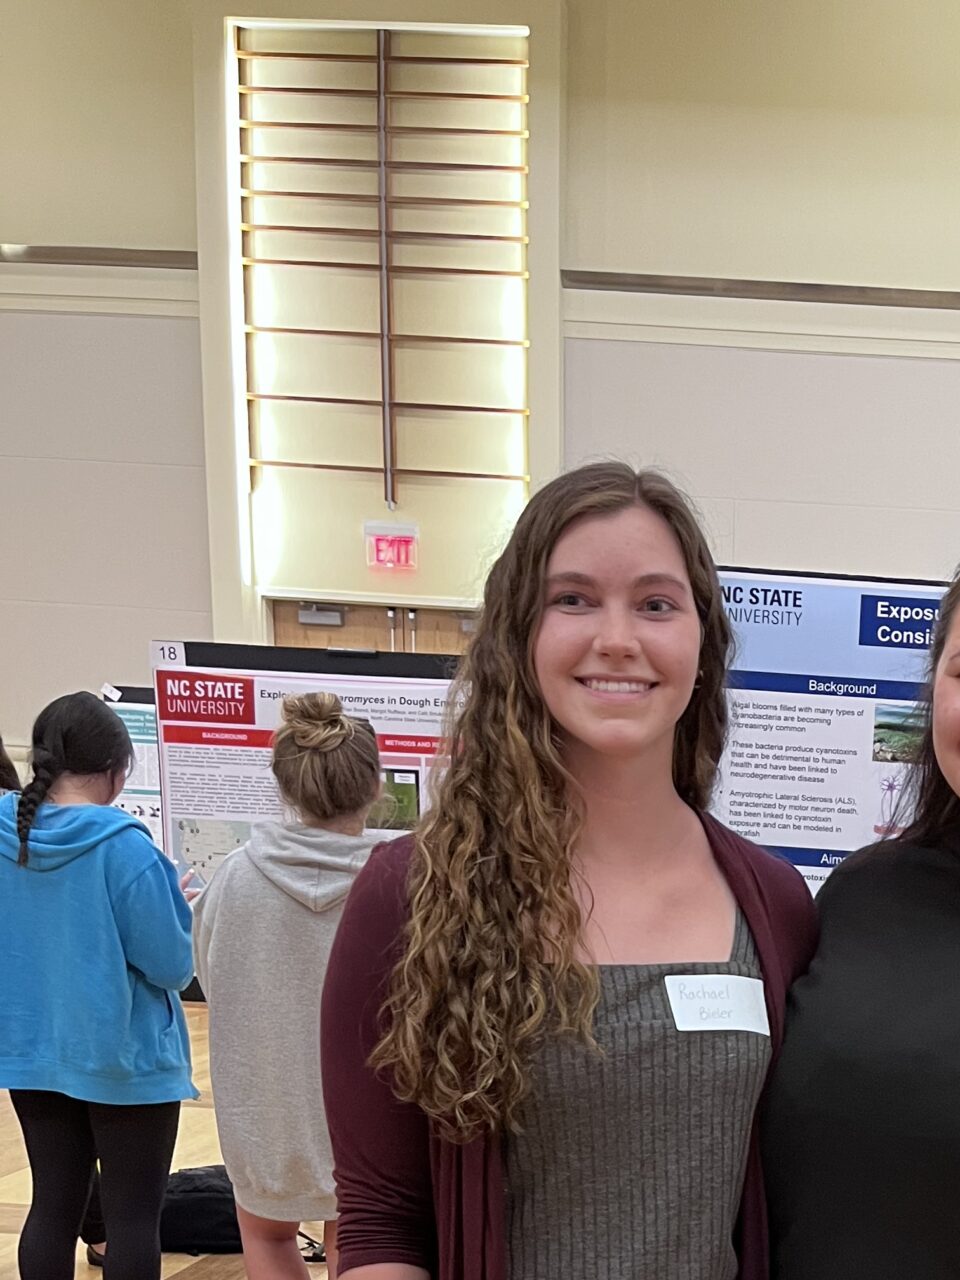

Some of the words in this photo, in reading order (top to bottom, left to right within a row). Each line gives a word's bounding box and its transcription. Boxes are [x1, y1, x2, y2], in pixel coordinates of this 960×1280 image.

[376, 536, 412, 564] EXIT
[721, 586, 744, 603] NC
[749, 588, 802, 608] STATE
[160, 646, 177, 660] 18
[166, 680, 190, 696] NC
[195, 681, 244, 699] STATE
[808, 680, 877, 696] Background
[260, 690, 287, 700] Explo
[339, 695, 384, 705] aromyces
[388, 696, 396, 704] in
[400, 697, 430, 708] Dough
[168, 699, 245, 716] UNIVERSITY
[732, 702, 751, 710] Algal
[780, 704, 796, 712] filled
[814, 708, 834, 716] many
[836, 708, 855, 717] types
[796, 716, 832, 726] becoming
[202, 732, 248, 740] BACKGROUND
[732, 740, 753, 749] These
[755, 742, 783, 750] bacteria
[785, 745, 814, 754] produce
[816, 747, 858, 756] cyanotoxins
[772, 754, 810, 762] detrimental
[822, 757, 846, 765] human
[730, 760, 752, 768] health
[754, 762, 768, 770] and
[769, 763, 786, 771] have
[788, 764, 806, 772] been
[808, 765, 829, 774] linked
[730, 771, 796, 782] neurodegenerative
[730, 790, 774, 800] Amyotrophic
[775, 792, 800, 800] Lateral
[801, 794, 832, 804] Sclerosis
[730, 800, 776, 809] characterized
[778, 803, 786, 811] by
[788, 804, 809, 812] motor
[763, 812, 784, 820] linked
[794, 814, 832, 823] cyanotoxin
[728, 820, 761, 828] exposure
[804, 824, 834, 832] modeled
[820, 853, 847, 864] Aim
[680, 983, 730, 1000] Rachael
